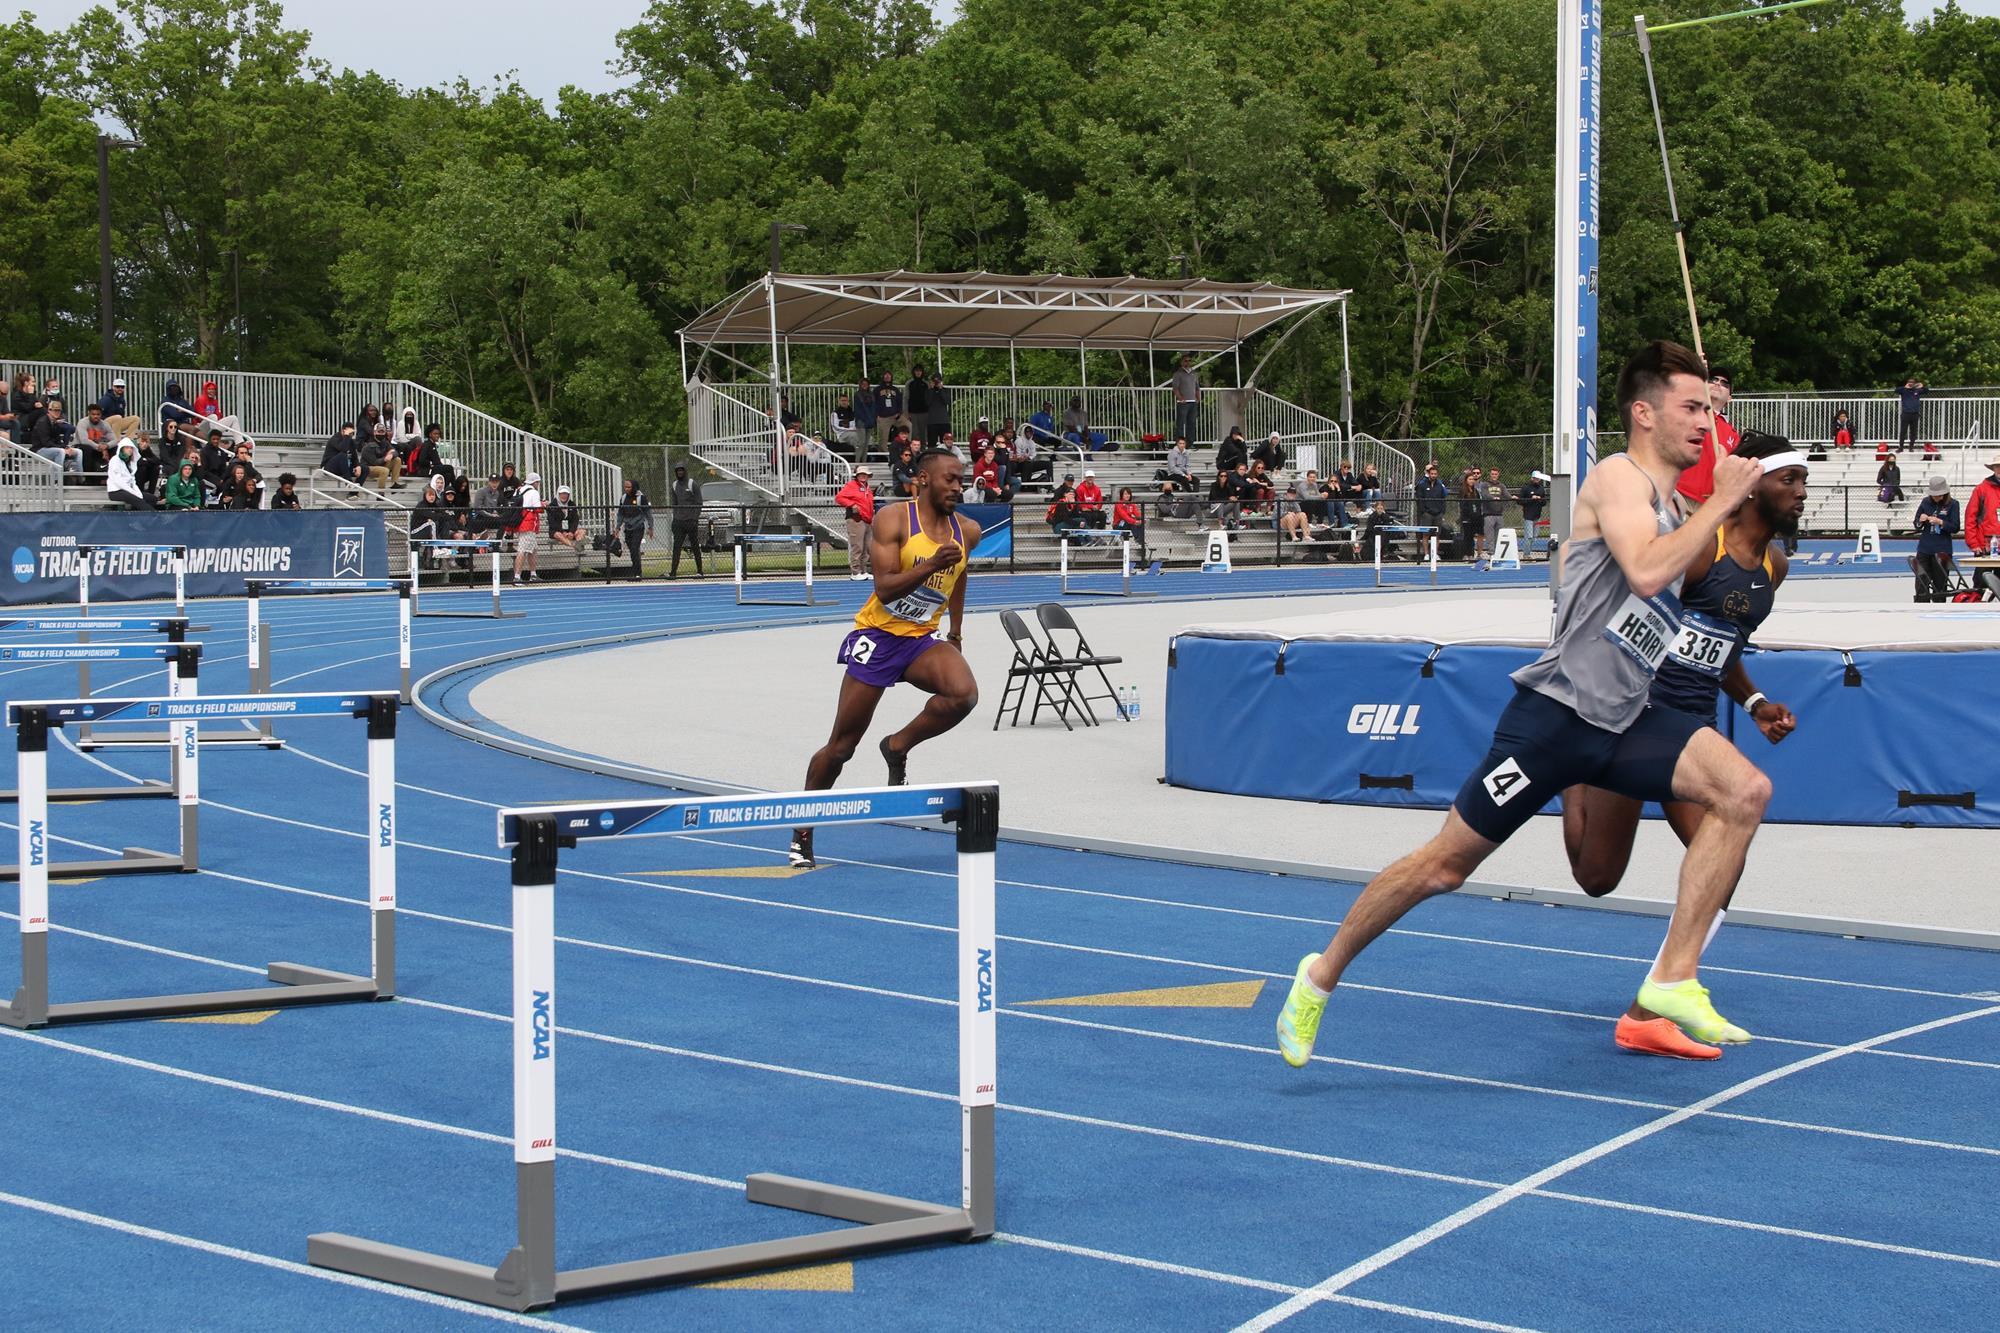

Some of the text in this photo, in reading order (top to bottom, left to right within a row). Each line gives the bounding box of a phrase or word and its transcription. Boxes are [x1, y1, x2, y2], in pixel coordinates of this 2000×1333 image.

[1581, 13, 1589, 29] 14
[1580, 66, 1588, 80] 13
[1580, 118, 1587, 133] 12
[1590, 34, 1600, 240] CHAMPIONSHIPS
[1579, 173, 1587, 181] 11
[1578, 221, 1586, 236] 10
[1578, 326, 1585, 338] 8
[41, 536, 77, 547] OUTDOOR
[1499, 541, 1510, 559] 7
[1861, 535, 1872, 553] 6
[1210, 544, 1222, 562] 8
[14, 563, 35, 574] NCAA
[93, 550, 106, 576] &
[108, 551, 151, 576] FIELD
[894, 600, 927, 618] KLAH
[1645, 611, 1666, 636] ROMAN
[1618, 612, 1665, 663] HENRY
[64, 649, 120, 657] CHAMPIONSHIPS
[853, 641, 870, 662] 2
[1679, 631, 1723, 664] 336
[168, 701, 297, 714] TRACK & FIELD CHAMPIONSHIPS
[1347, 704, 1420, 734] GILL
[185, 726, 195, 758] NCAA
[1492, 772, 1522, 798] 4
[927, 797, 944, 805] GILL
[709, 800, 871, 824] TRACK & FIELD CHAMPIONSHIPS
[380, 803, 392, 847] NCAA
[569, 818, 590, 828] GILL
[30, 820, 43, 866] NCAA
[977, 948, 993, 1014] NCAA
[533, 990, 550, 1061] NCAA
[976, 1084, 994, 1094] GILL
[532, 1138, 553, 1149] GILL
